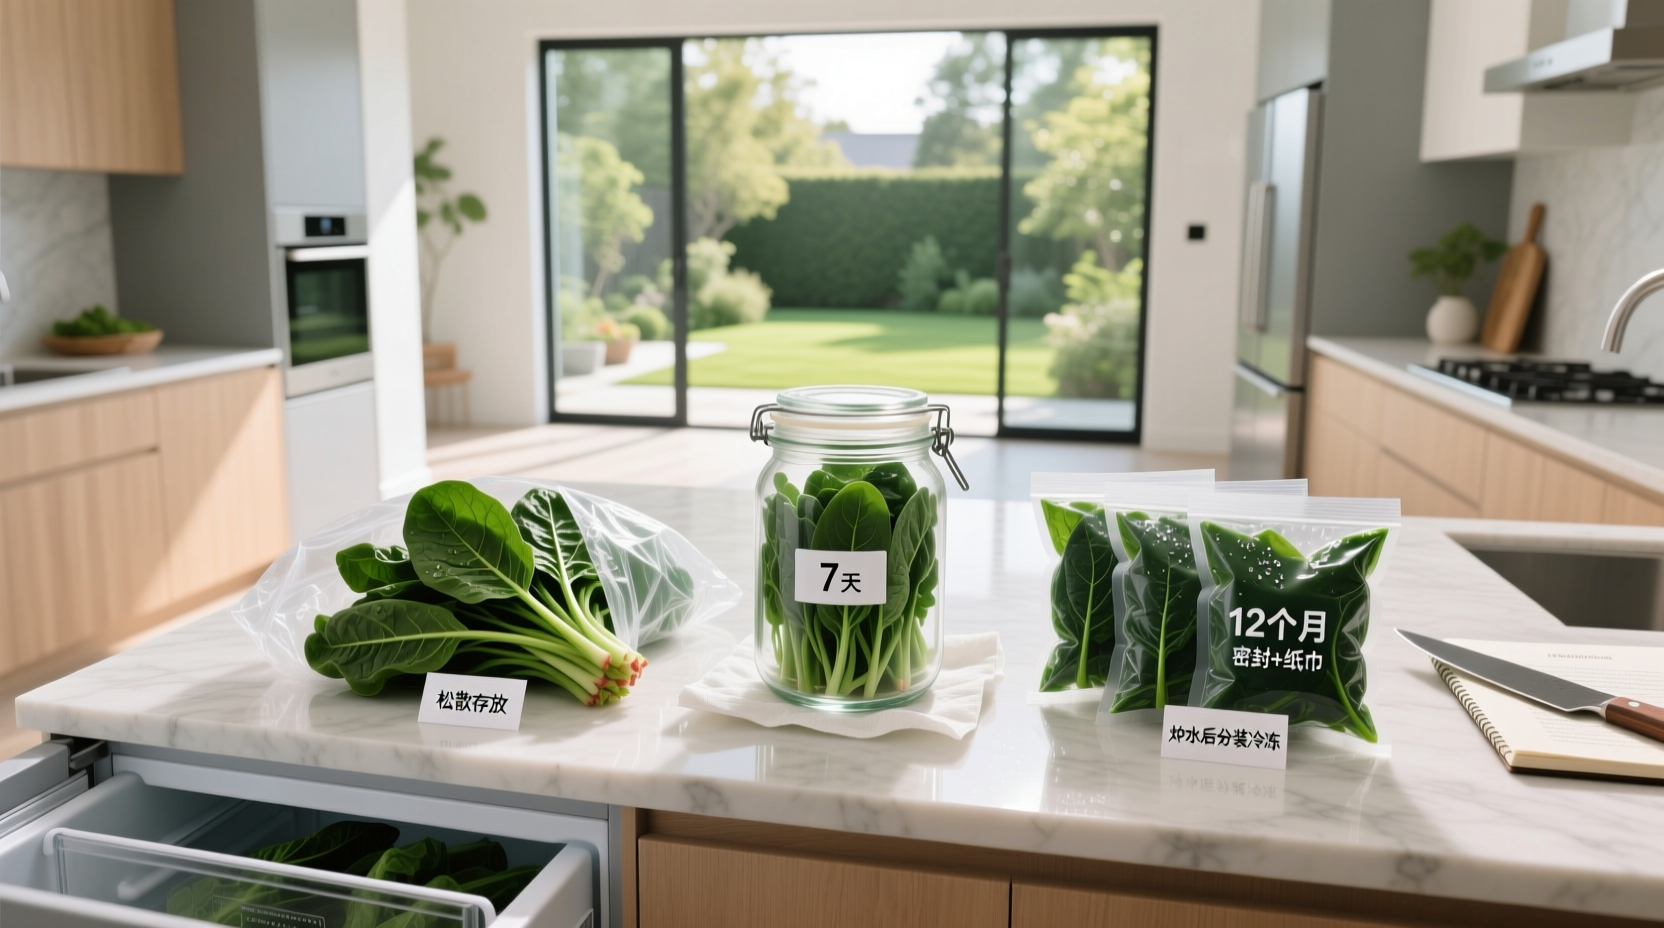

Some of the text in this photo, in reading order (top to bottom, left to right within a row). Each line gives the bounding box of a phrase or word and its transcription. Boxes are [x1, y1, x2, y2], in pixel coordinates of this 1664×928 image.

[820, 562, 862, 594] 7天
[1228, 607, 1327, 644] 12个月
[1232, 645, 1323, 672] 密封+纸巾
[435, 689, 509, 715] 松散存放
